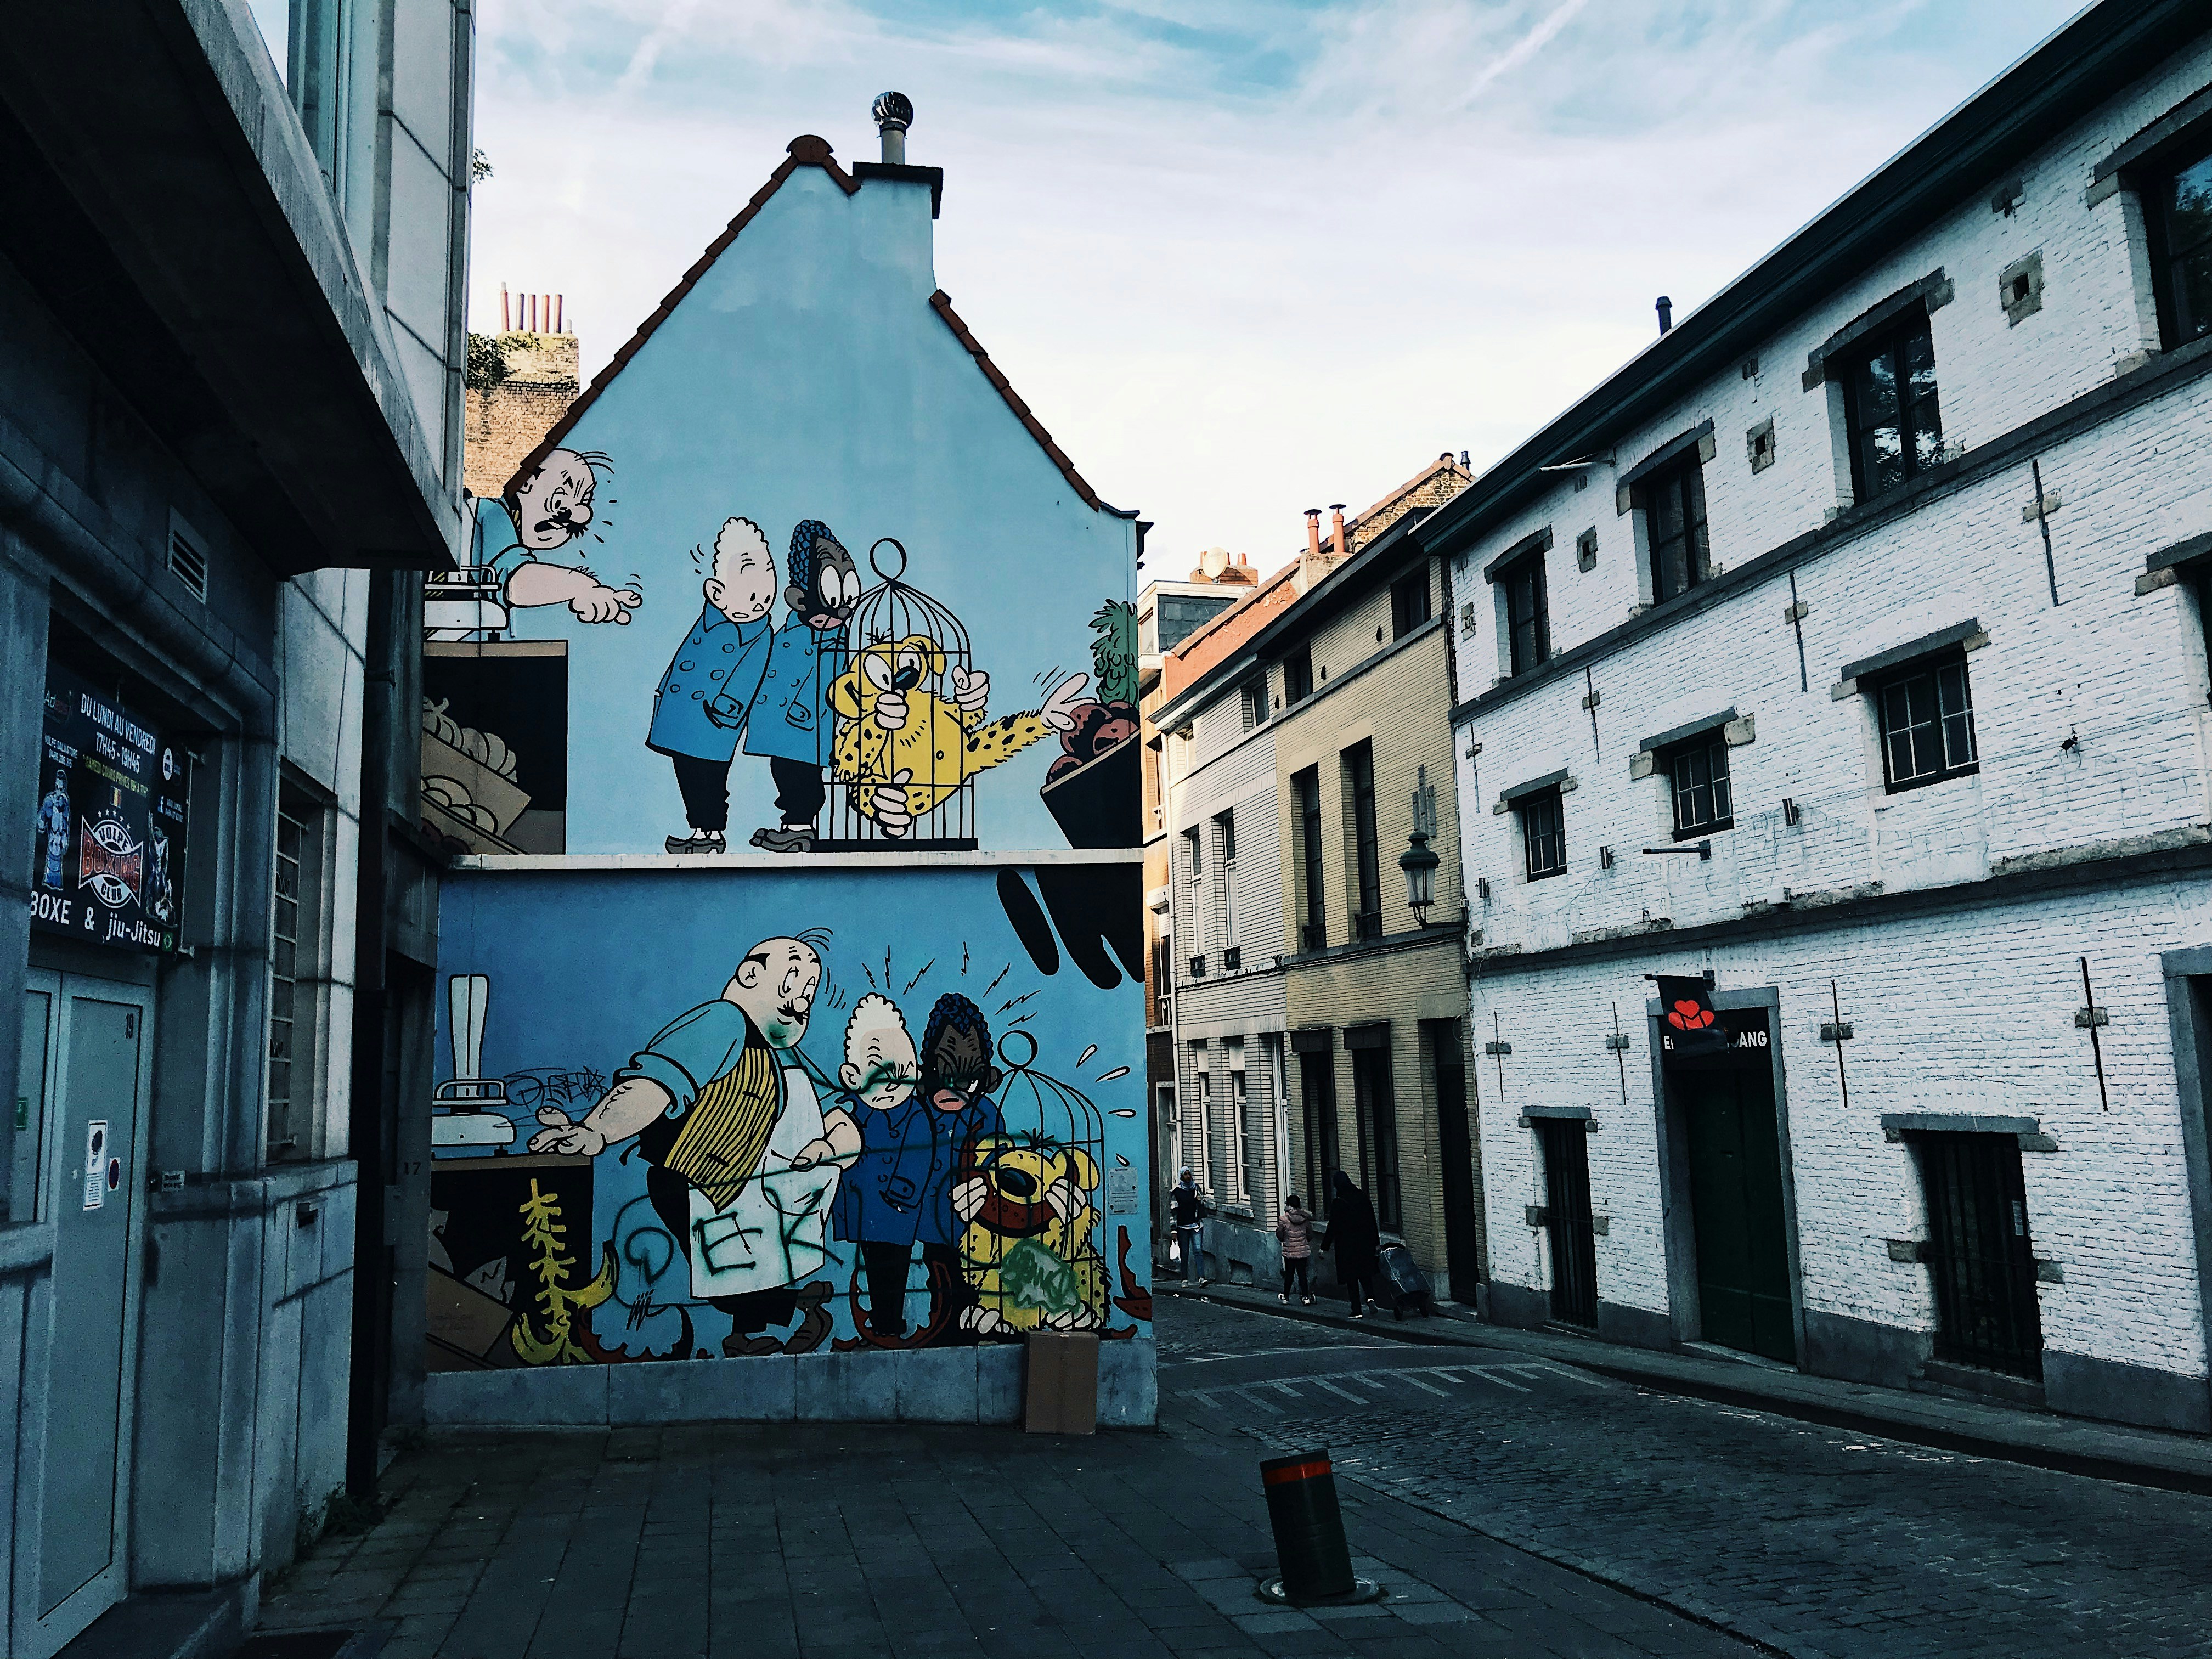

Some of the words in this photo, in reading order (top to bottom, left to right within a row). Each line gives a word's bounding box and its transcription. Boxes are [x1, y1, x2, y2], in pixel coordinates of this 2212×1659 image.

[81, 693, 93, 717] DU
[92, 700, 114, 731] LUNDI
[114, 714, 125, 736] AU
[125, 720, 157, 756] VENDREDI
[95, 731, 116, 760] 17H45
[121, 746, 141, 774] 19H45
[82, 829, 140, 893] BOXING
[99, 826, 128, 852] VOLPE
[101, 883, 122, 900] CLUB
[31, 890, 72, 926] BOXE
[84, 906, 95, 932] &
[106, 912, 161, 947] jiu-Jitsu
